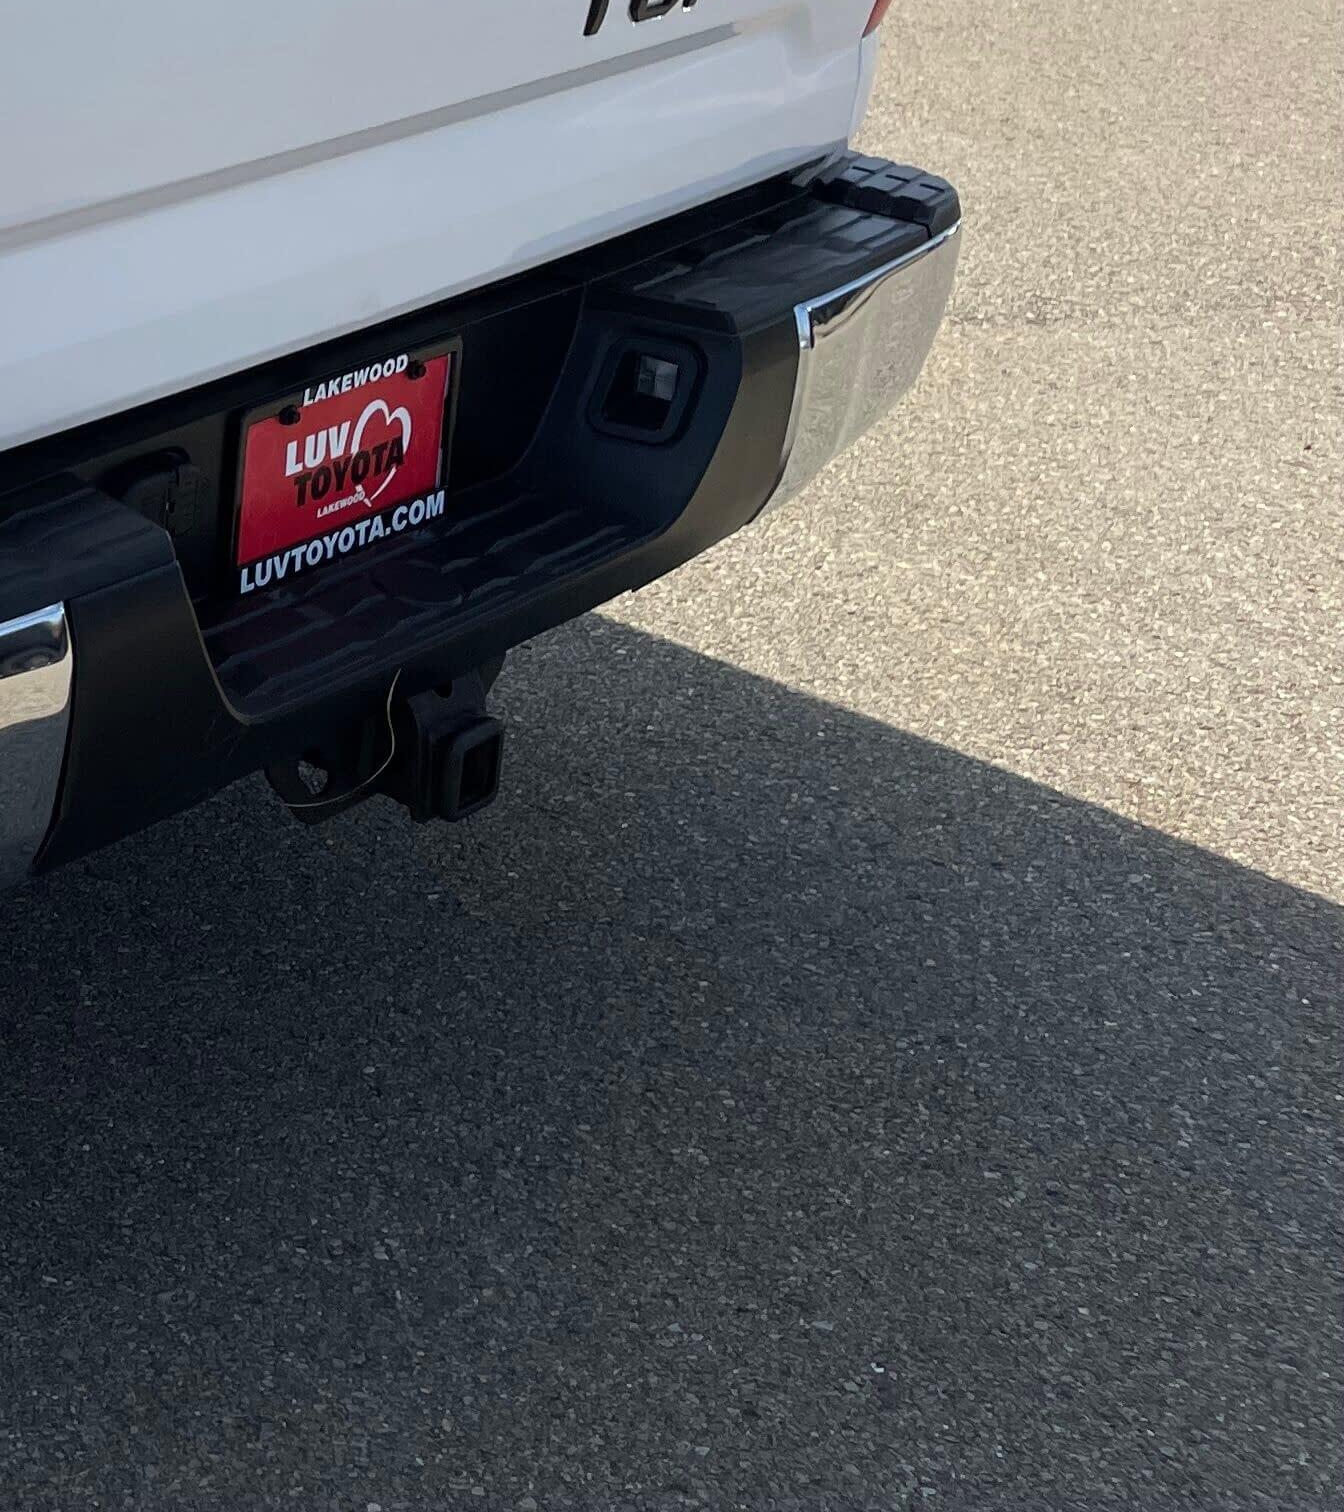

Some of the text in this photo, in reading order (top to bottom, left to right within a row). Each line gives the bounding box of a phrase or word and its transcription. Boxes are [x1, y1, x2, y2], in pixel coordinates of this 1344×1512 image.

[303, 354, 409, 406] LAKEWOOD
[285, 420, 351, 477] LUV
[293, 435, 405, 507] TOYOTA
[316, 490, 366, 518] LAKEWOOD
[240, 490, 446, 595] LUVTOYOTA.COM
